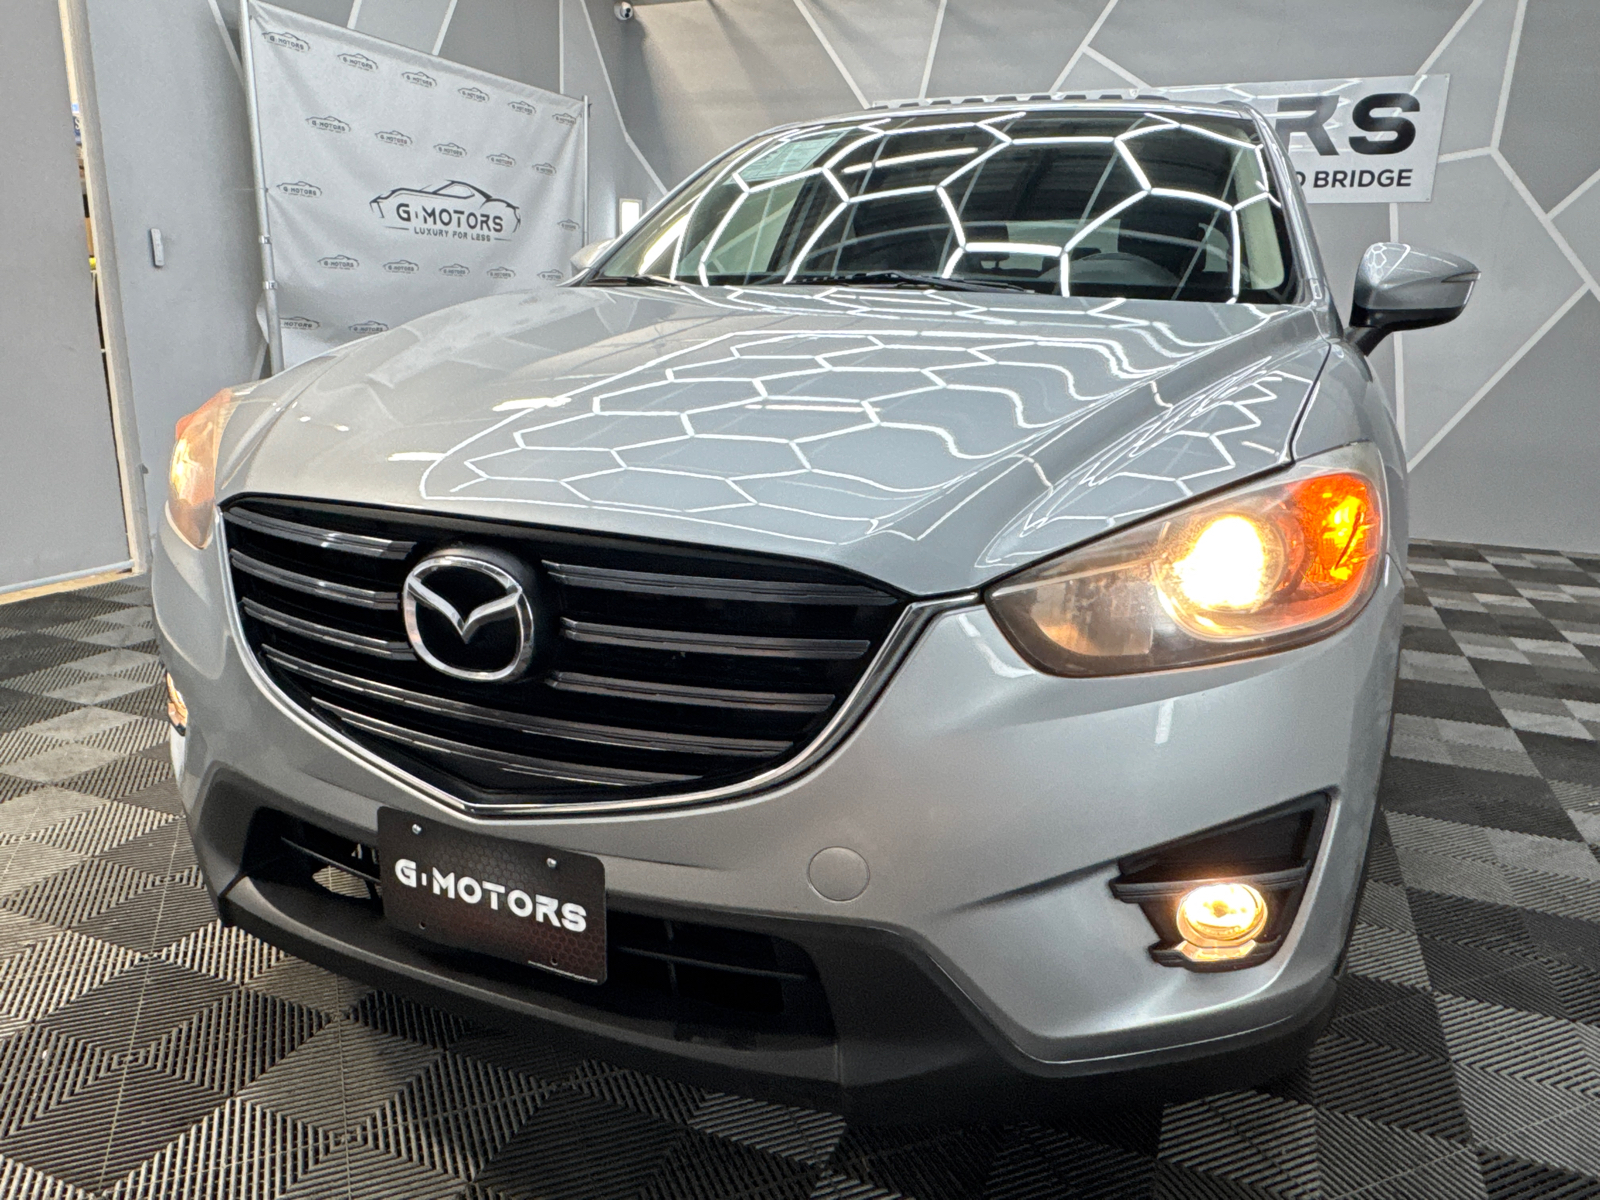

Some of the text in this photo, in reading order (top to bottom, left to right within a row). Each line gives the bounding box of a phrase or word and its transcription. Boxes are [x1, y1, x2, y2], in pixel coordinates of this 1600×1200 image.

[1313, 168, 1413, 188] BRIDGE
[413, 227, 492, 242] LUXURY FOR LESS
